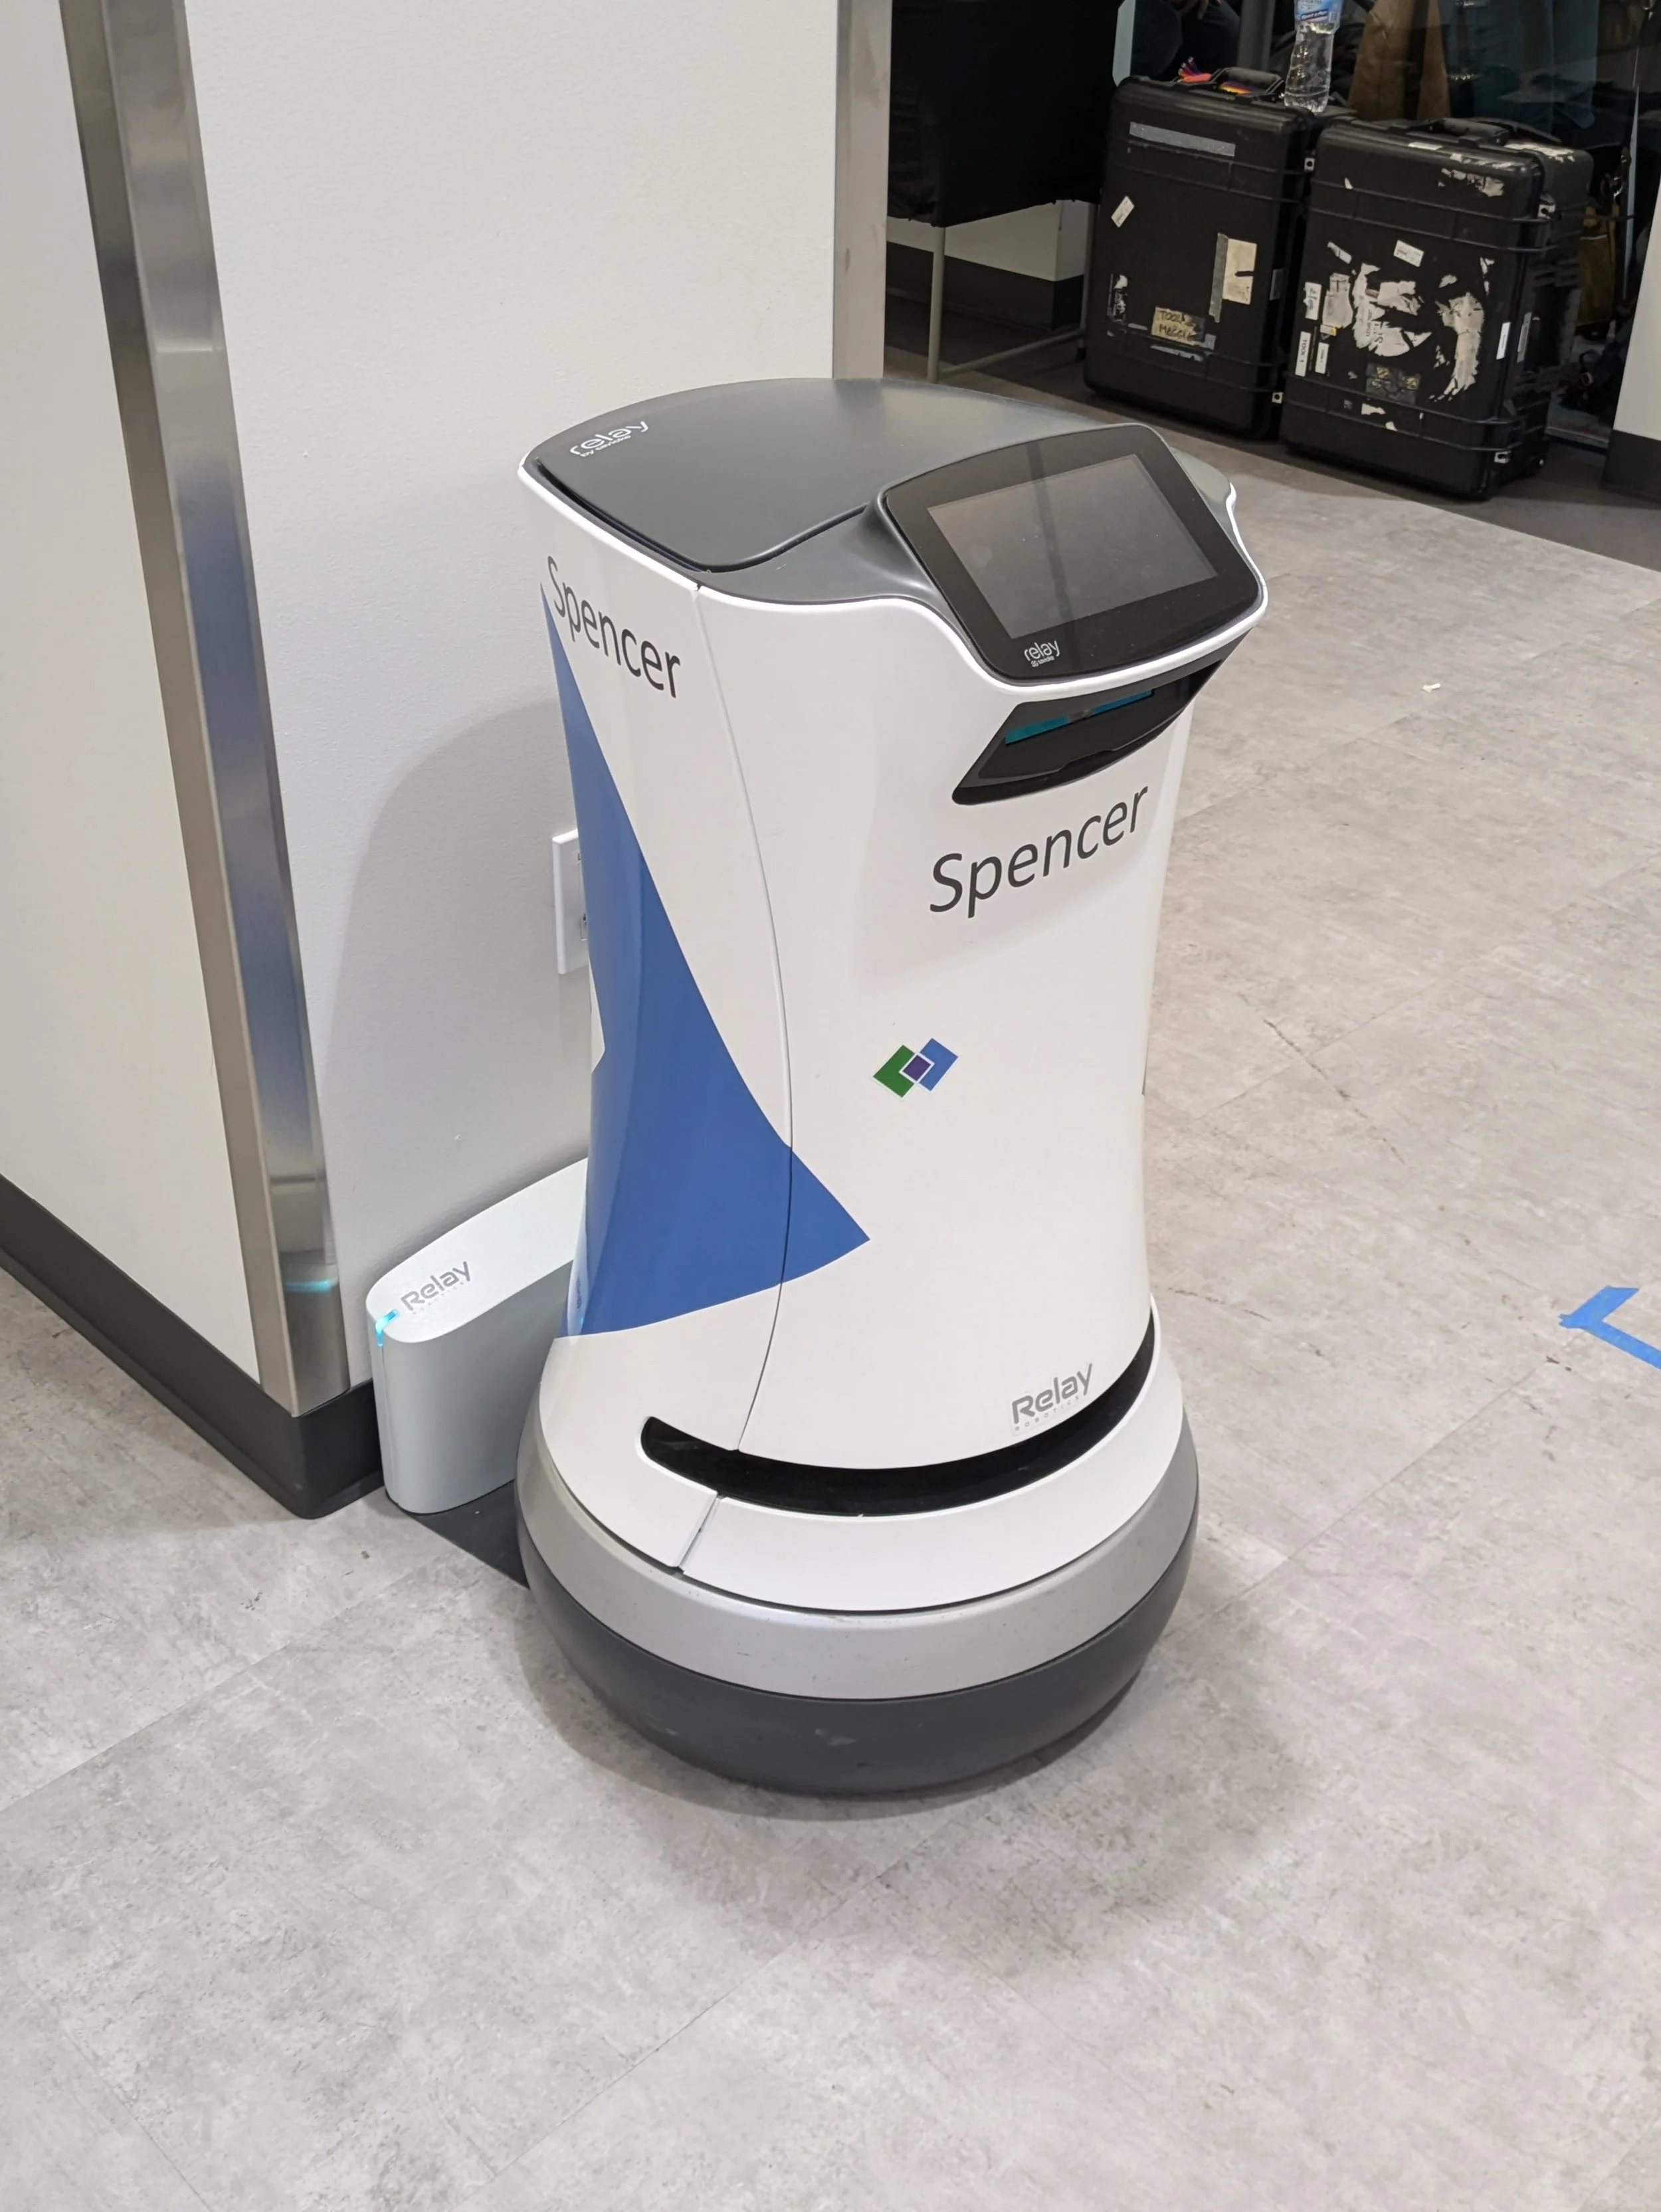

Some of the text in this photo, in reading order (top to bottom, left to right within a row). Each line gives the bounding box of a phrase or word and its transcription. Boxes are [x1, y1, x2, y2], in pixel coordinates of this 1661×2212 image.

[569, 420, 649, 457] relay
[547, 555, 682, 699] Spencer
[1024, 640, 1060, 662] relay
[929, 785, 1149, 919] Spencer
[401, 1260, 472, 1312] Relay
[1011, 1363, 1093, 1425] Relay
